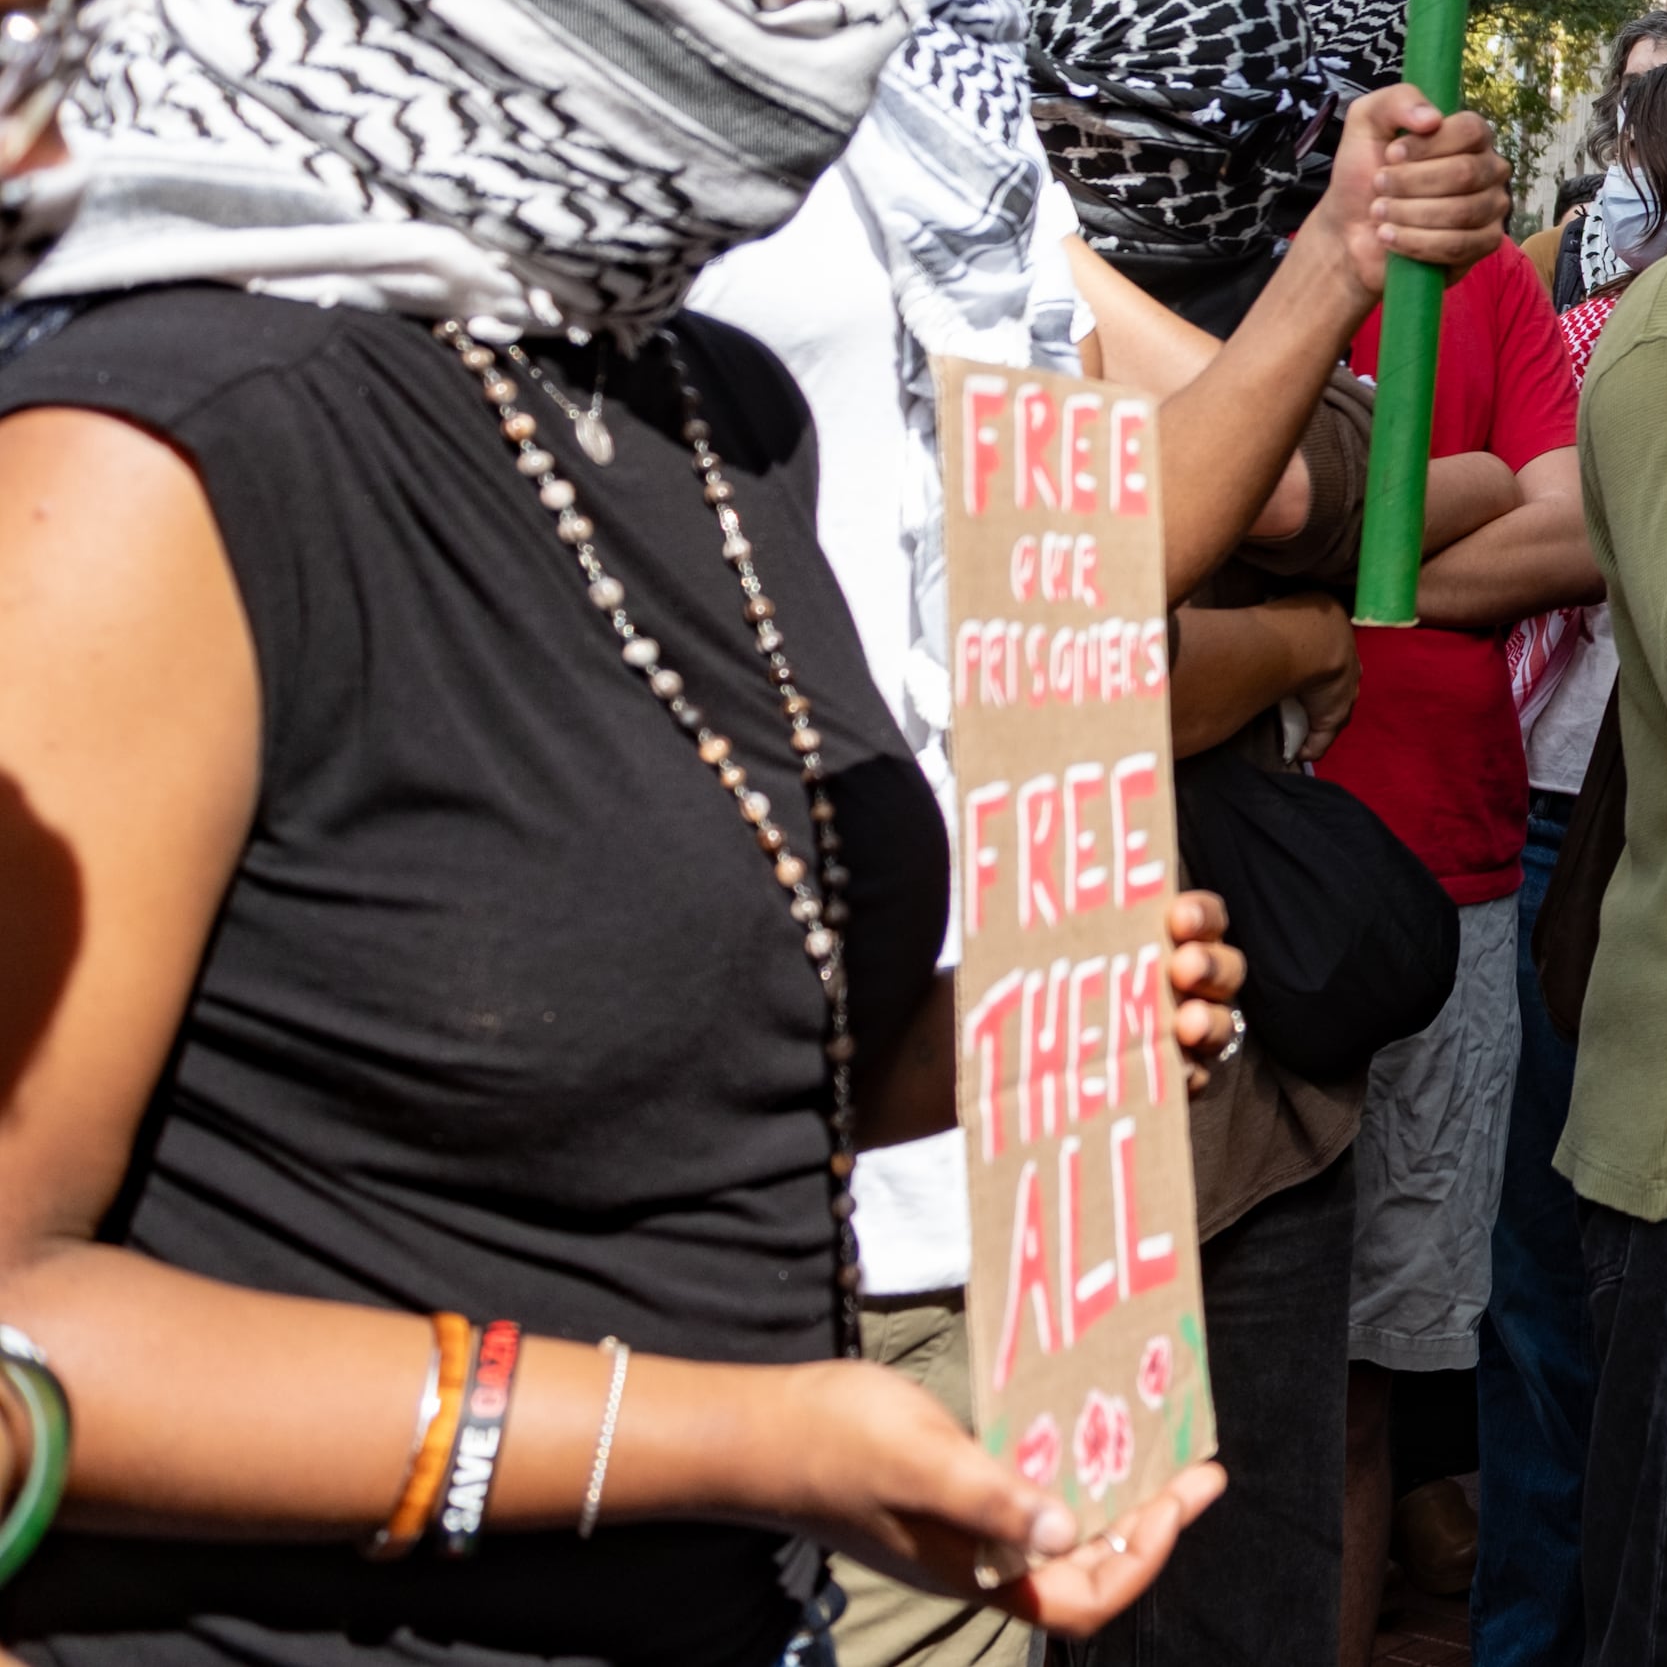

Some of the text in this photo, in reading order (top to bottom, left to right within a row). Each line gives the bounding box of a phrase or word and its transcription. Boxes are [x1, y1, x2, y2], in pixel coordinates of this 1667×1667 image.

[962, 374, 1152, 517] FREE
[1010, 530, 1107, 608] OUR
[955, 616, 1169, 710] PRISONERS
[965, 752, 1166, 934] FREE
[964, 942, 1167, 1164] THEM
[994, 1116, 1178, 1391] ALL
[443, 1425, 502, 1534] SAVE
